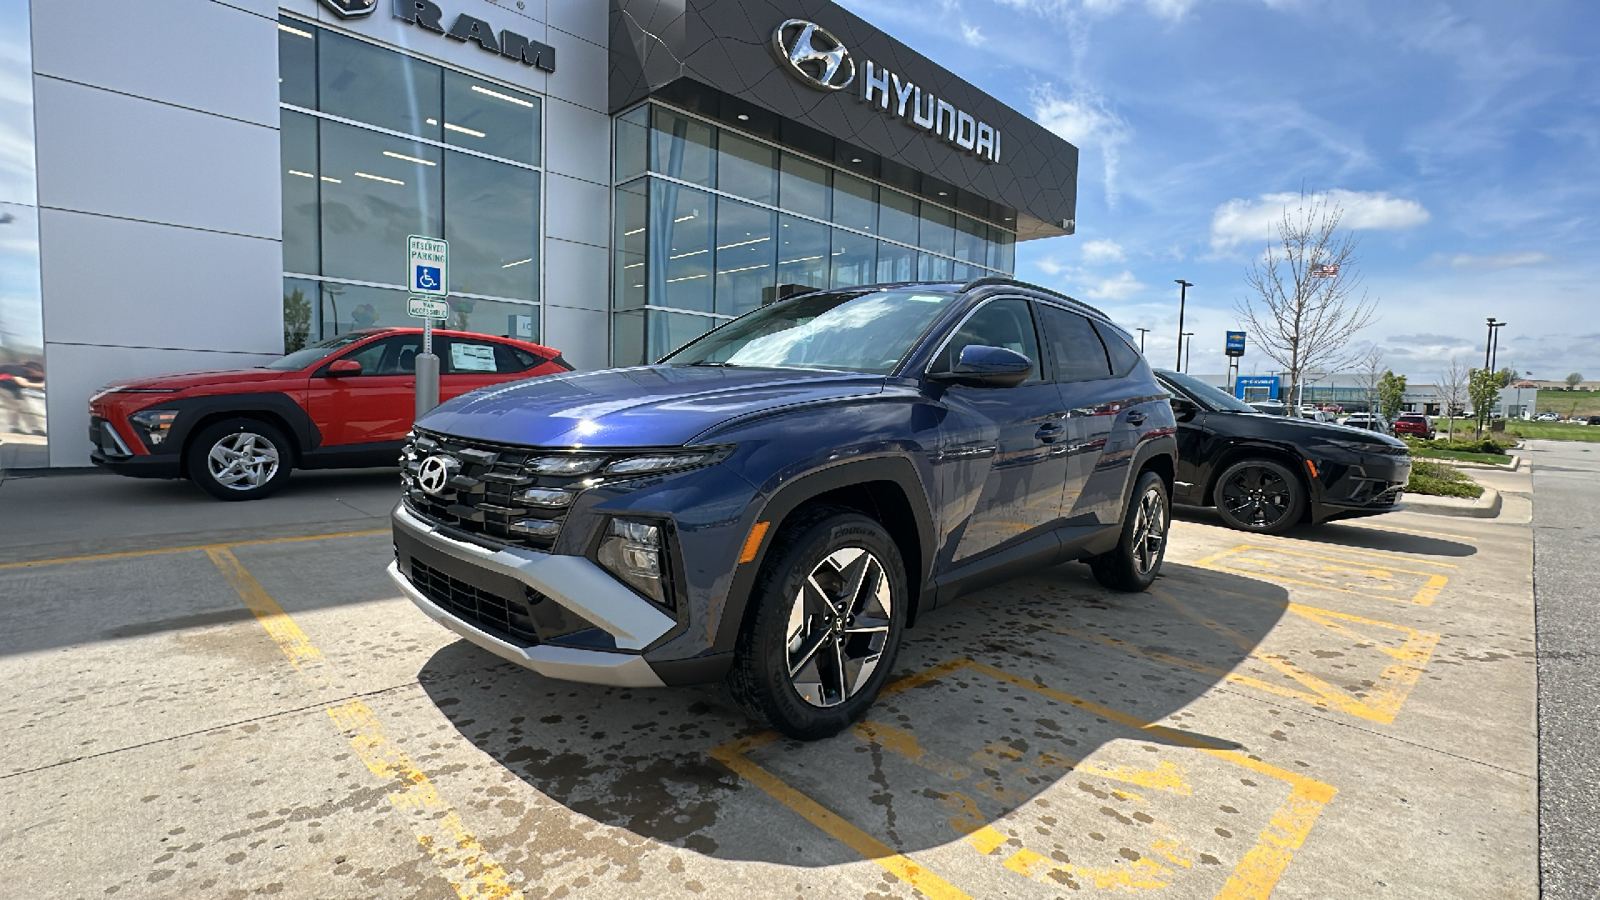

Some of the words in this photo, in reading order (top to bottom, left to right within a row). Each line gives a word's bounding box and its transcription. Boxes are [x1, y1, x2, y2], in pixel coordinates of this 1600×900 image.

[393, 0, 555, 72] RAM
[860, 60, 1001, 163] HYUNDAI
[411, 241, 445, 253] RESERVED
[411, 251, 445, 262] PARKING
[411, 307, 446, 316] ACCESSIBLE
